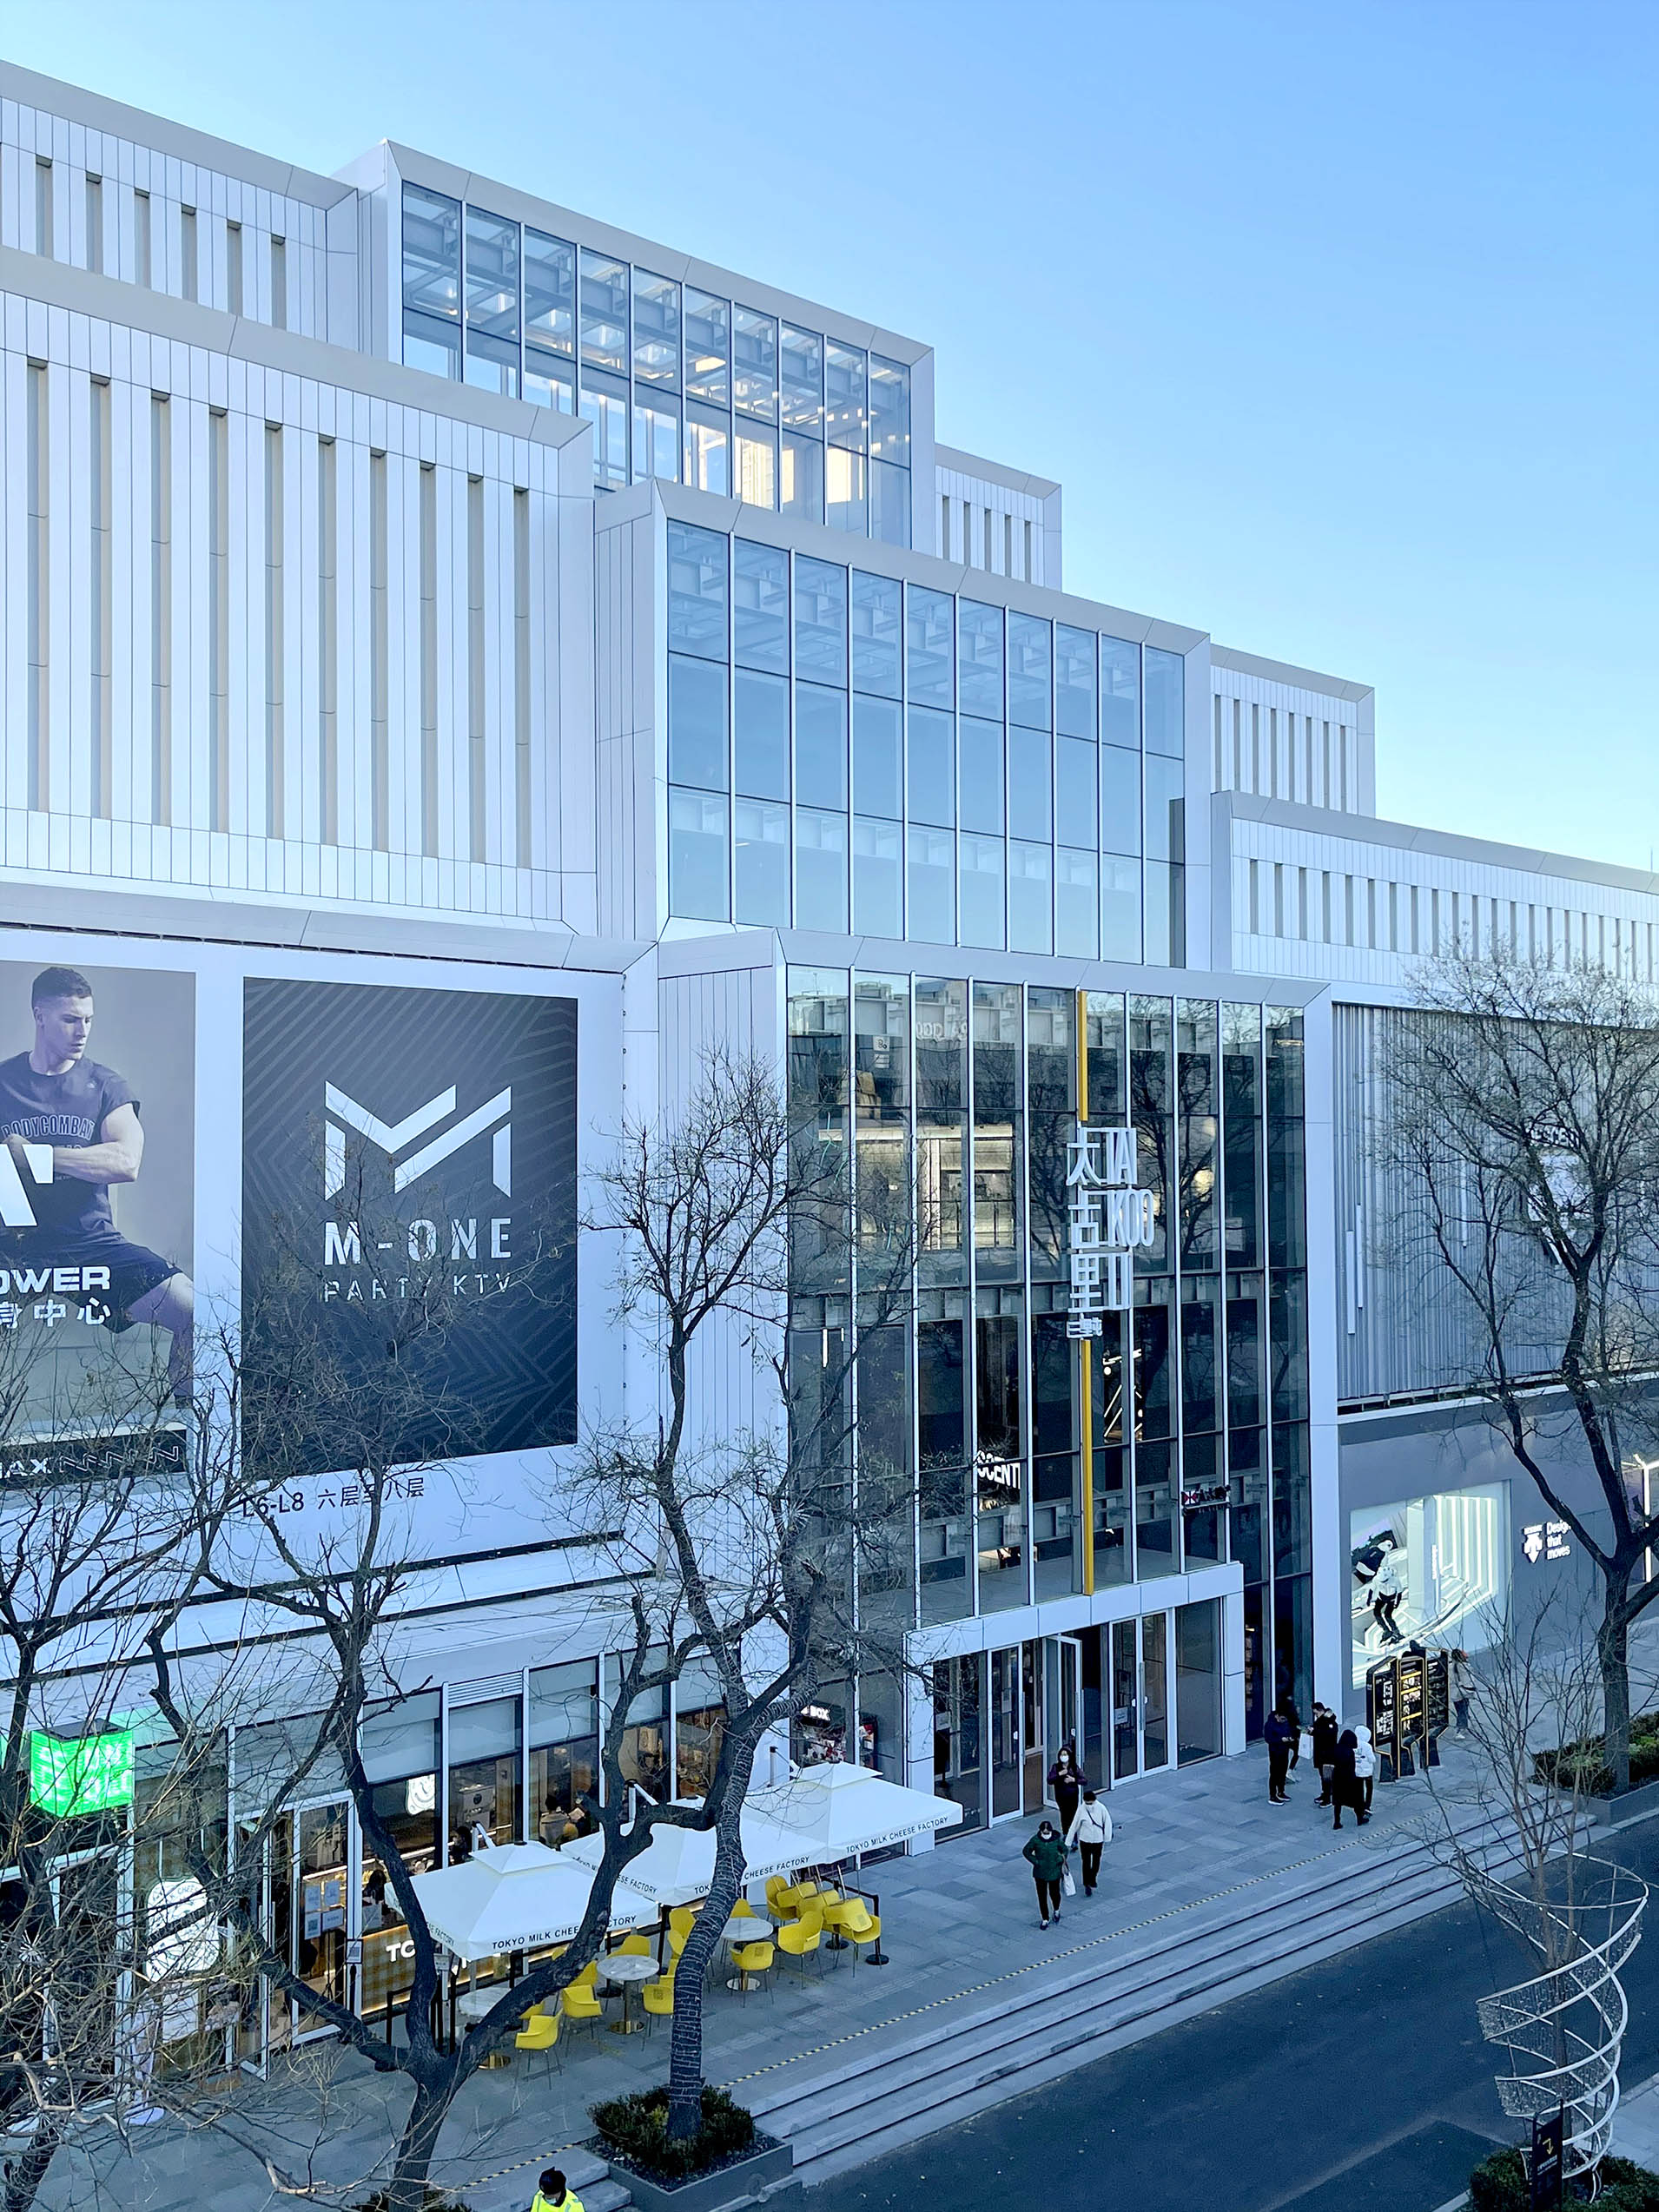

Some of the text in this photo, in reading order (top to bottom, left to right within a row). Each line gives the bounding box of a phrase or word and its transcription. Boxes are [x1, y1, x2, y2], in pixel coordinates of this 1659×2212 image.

[1106, 1127, 1137, 1185] TAI
[1066, 1127, 1101, 1313] 太古里
[1107, 1188, 1154, 1247] KOO
[324, 1218, 512, 1265] M-ONE
[453, 1273, 510, 1295] KTV
[846, 1816, 948, 1854] TOKYO MILK CHEESE FACTORY
[694, 1855, 810, 1896] TOK CHEESE FACTORY
[492, 1915, 637, 1950] TOKYO MILK CHEE CTORY
